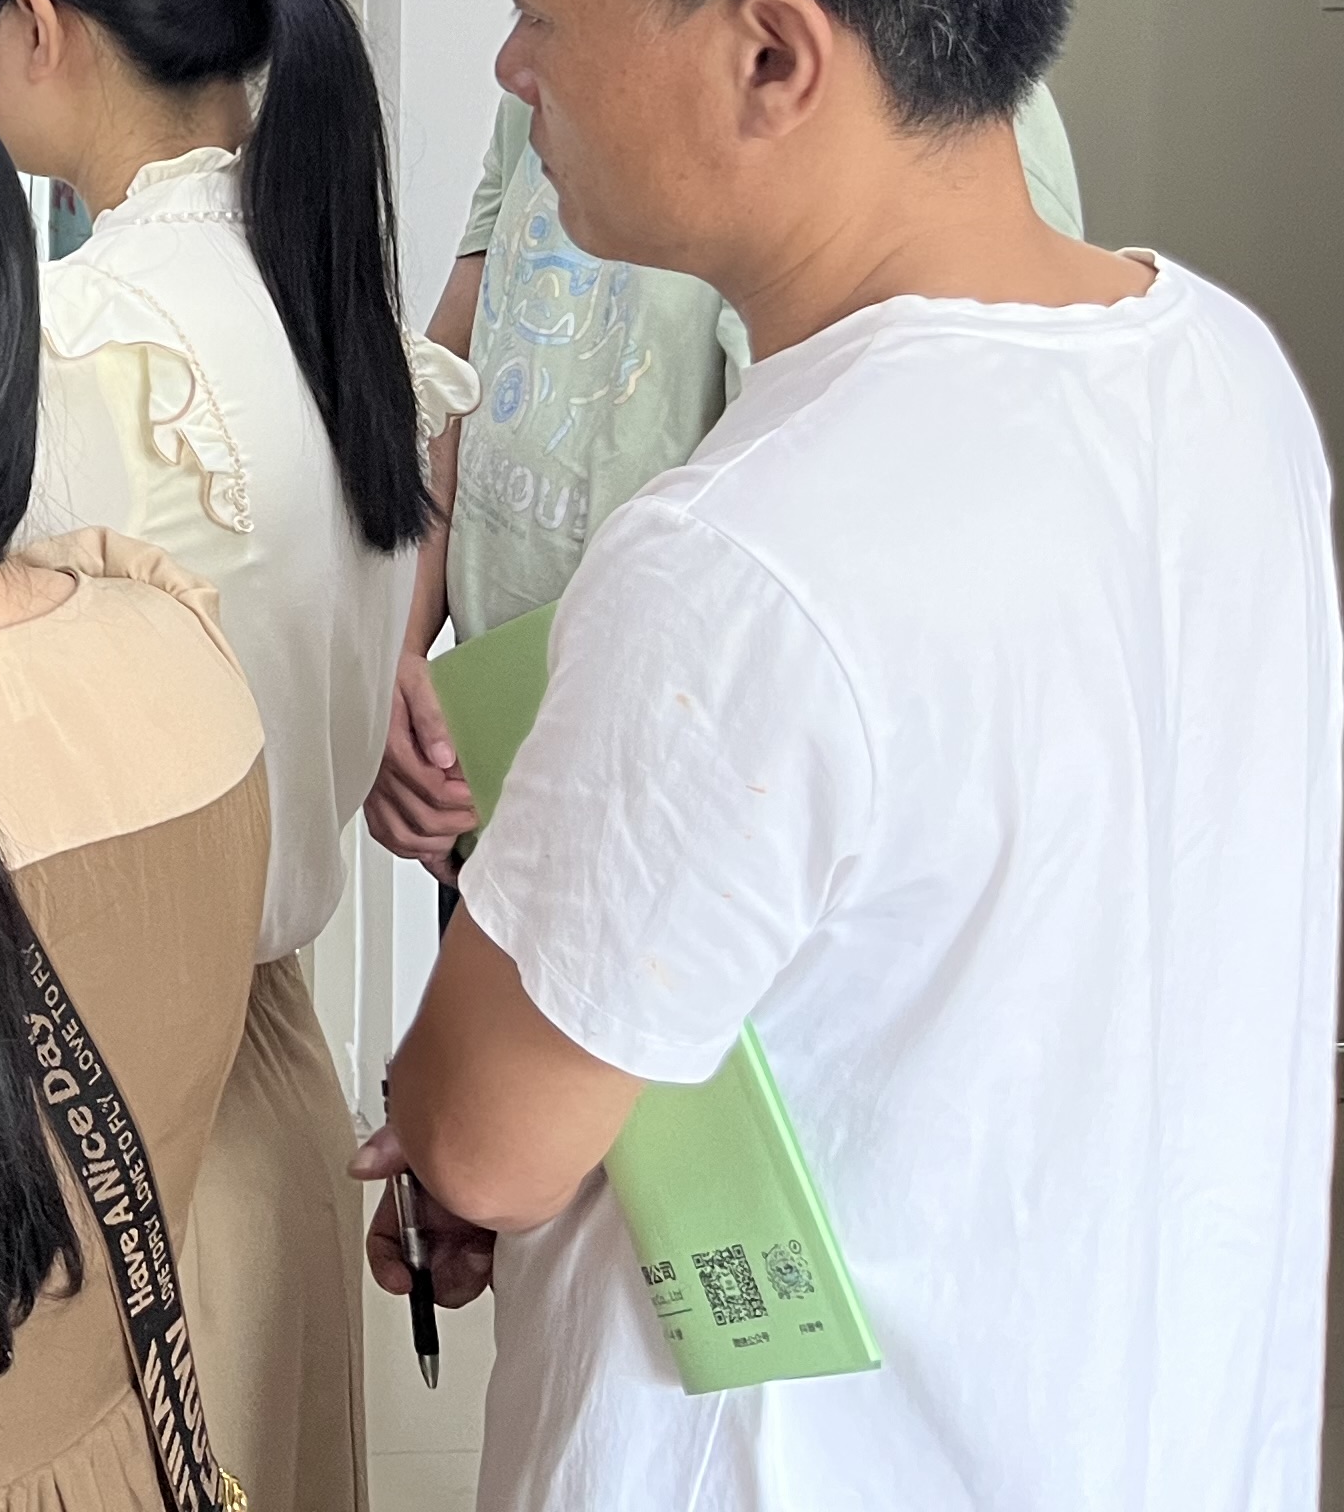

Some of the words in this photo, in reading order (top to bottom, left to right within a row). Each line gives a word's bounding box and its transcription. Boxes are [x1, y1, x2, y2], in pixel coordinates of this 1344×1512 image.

[23, 1013, 80, 1105] Day
[61, 1018, 102, 1086] LOVE
[103, 1195, 134, 1226] A
[119, 1227, 155, 1317] Have
